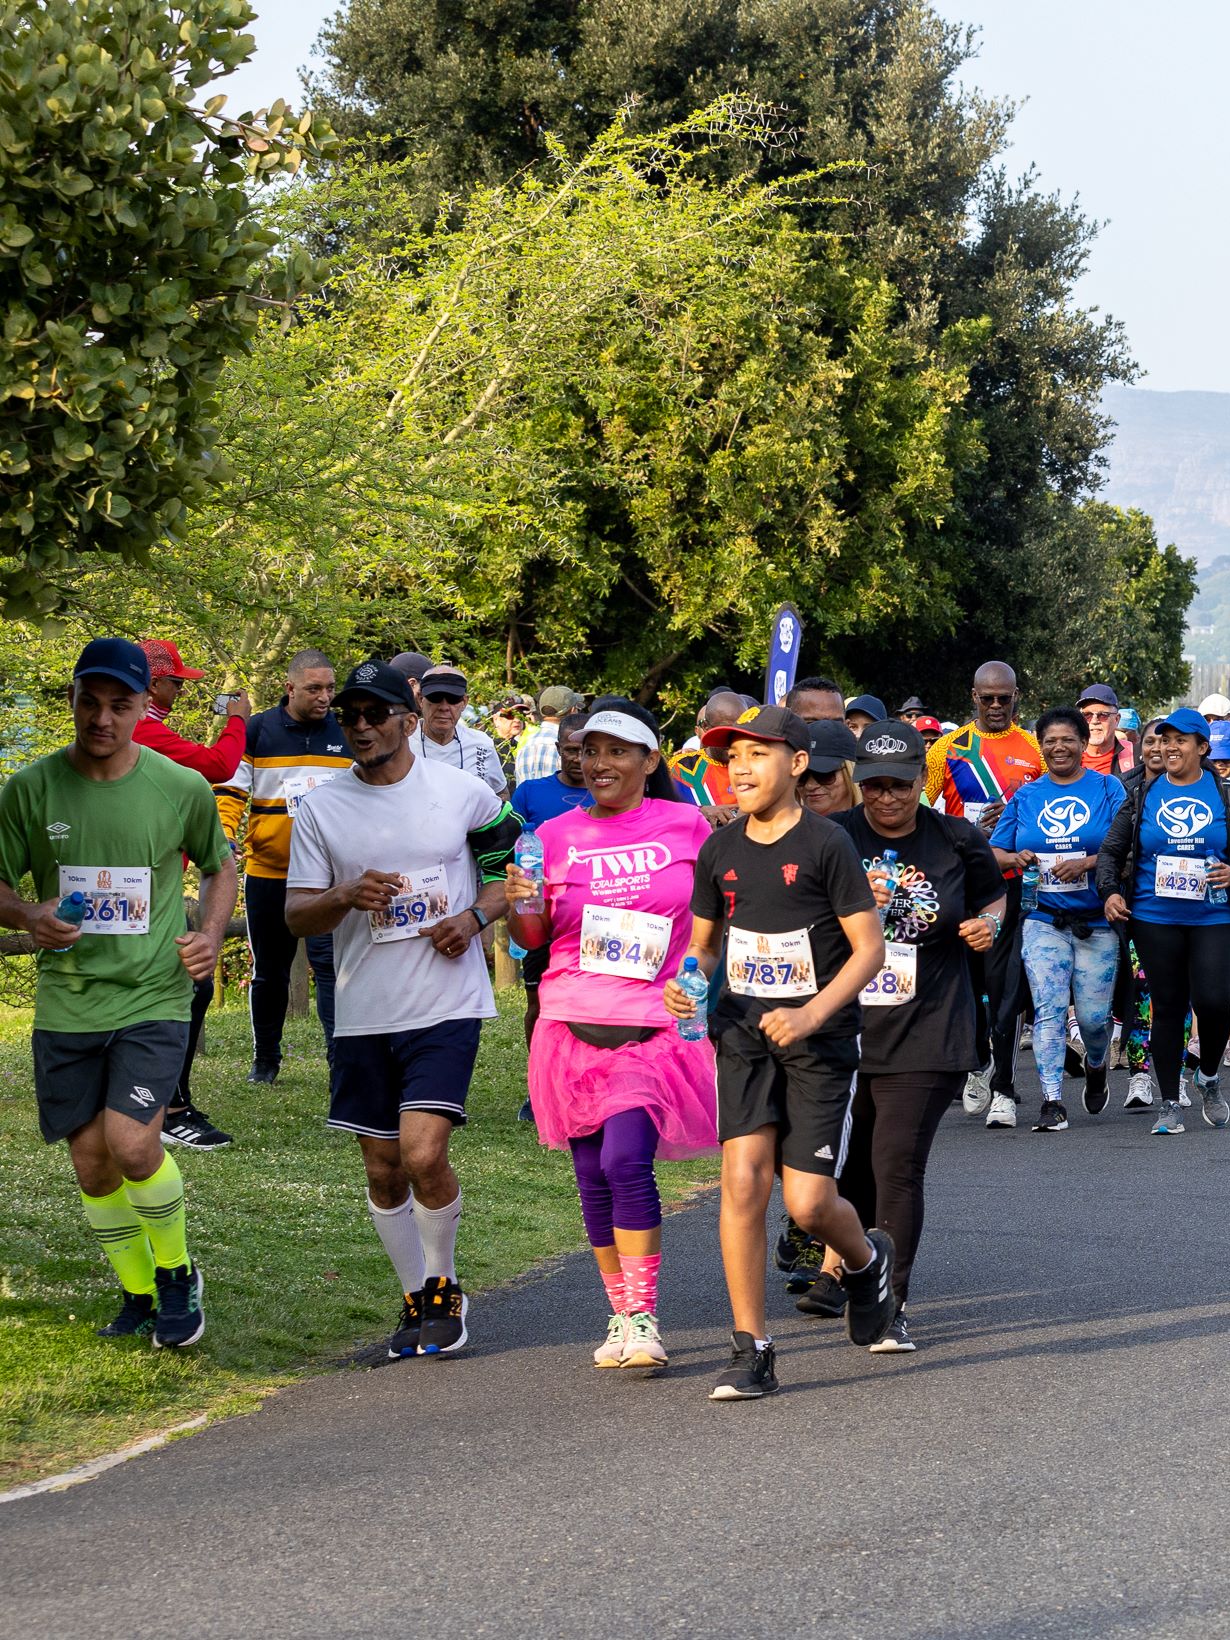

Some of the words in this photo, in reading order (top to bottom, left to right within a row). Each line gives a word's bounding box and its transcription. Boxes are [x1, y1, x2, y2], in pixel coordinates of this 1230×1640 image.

[1168, 837, 1194, 845] Lavender
[422, 875, 440, 884] 10km
[590, 874, 650, 889] TOTALSPORTS
[1166, 876, 1199, 892] 429
[84, 899, 128, 922] 561
[394, 901, 427, 928] 59
[592, 914, 611, 922] 10km
[646, 922, 664, 932] 10km
[781, 940, 801, 948] 10km
[606, 939, 642, 965] 84
[744, 962, 793, 986] 787
